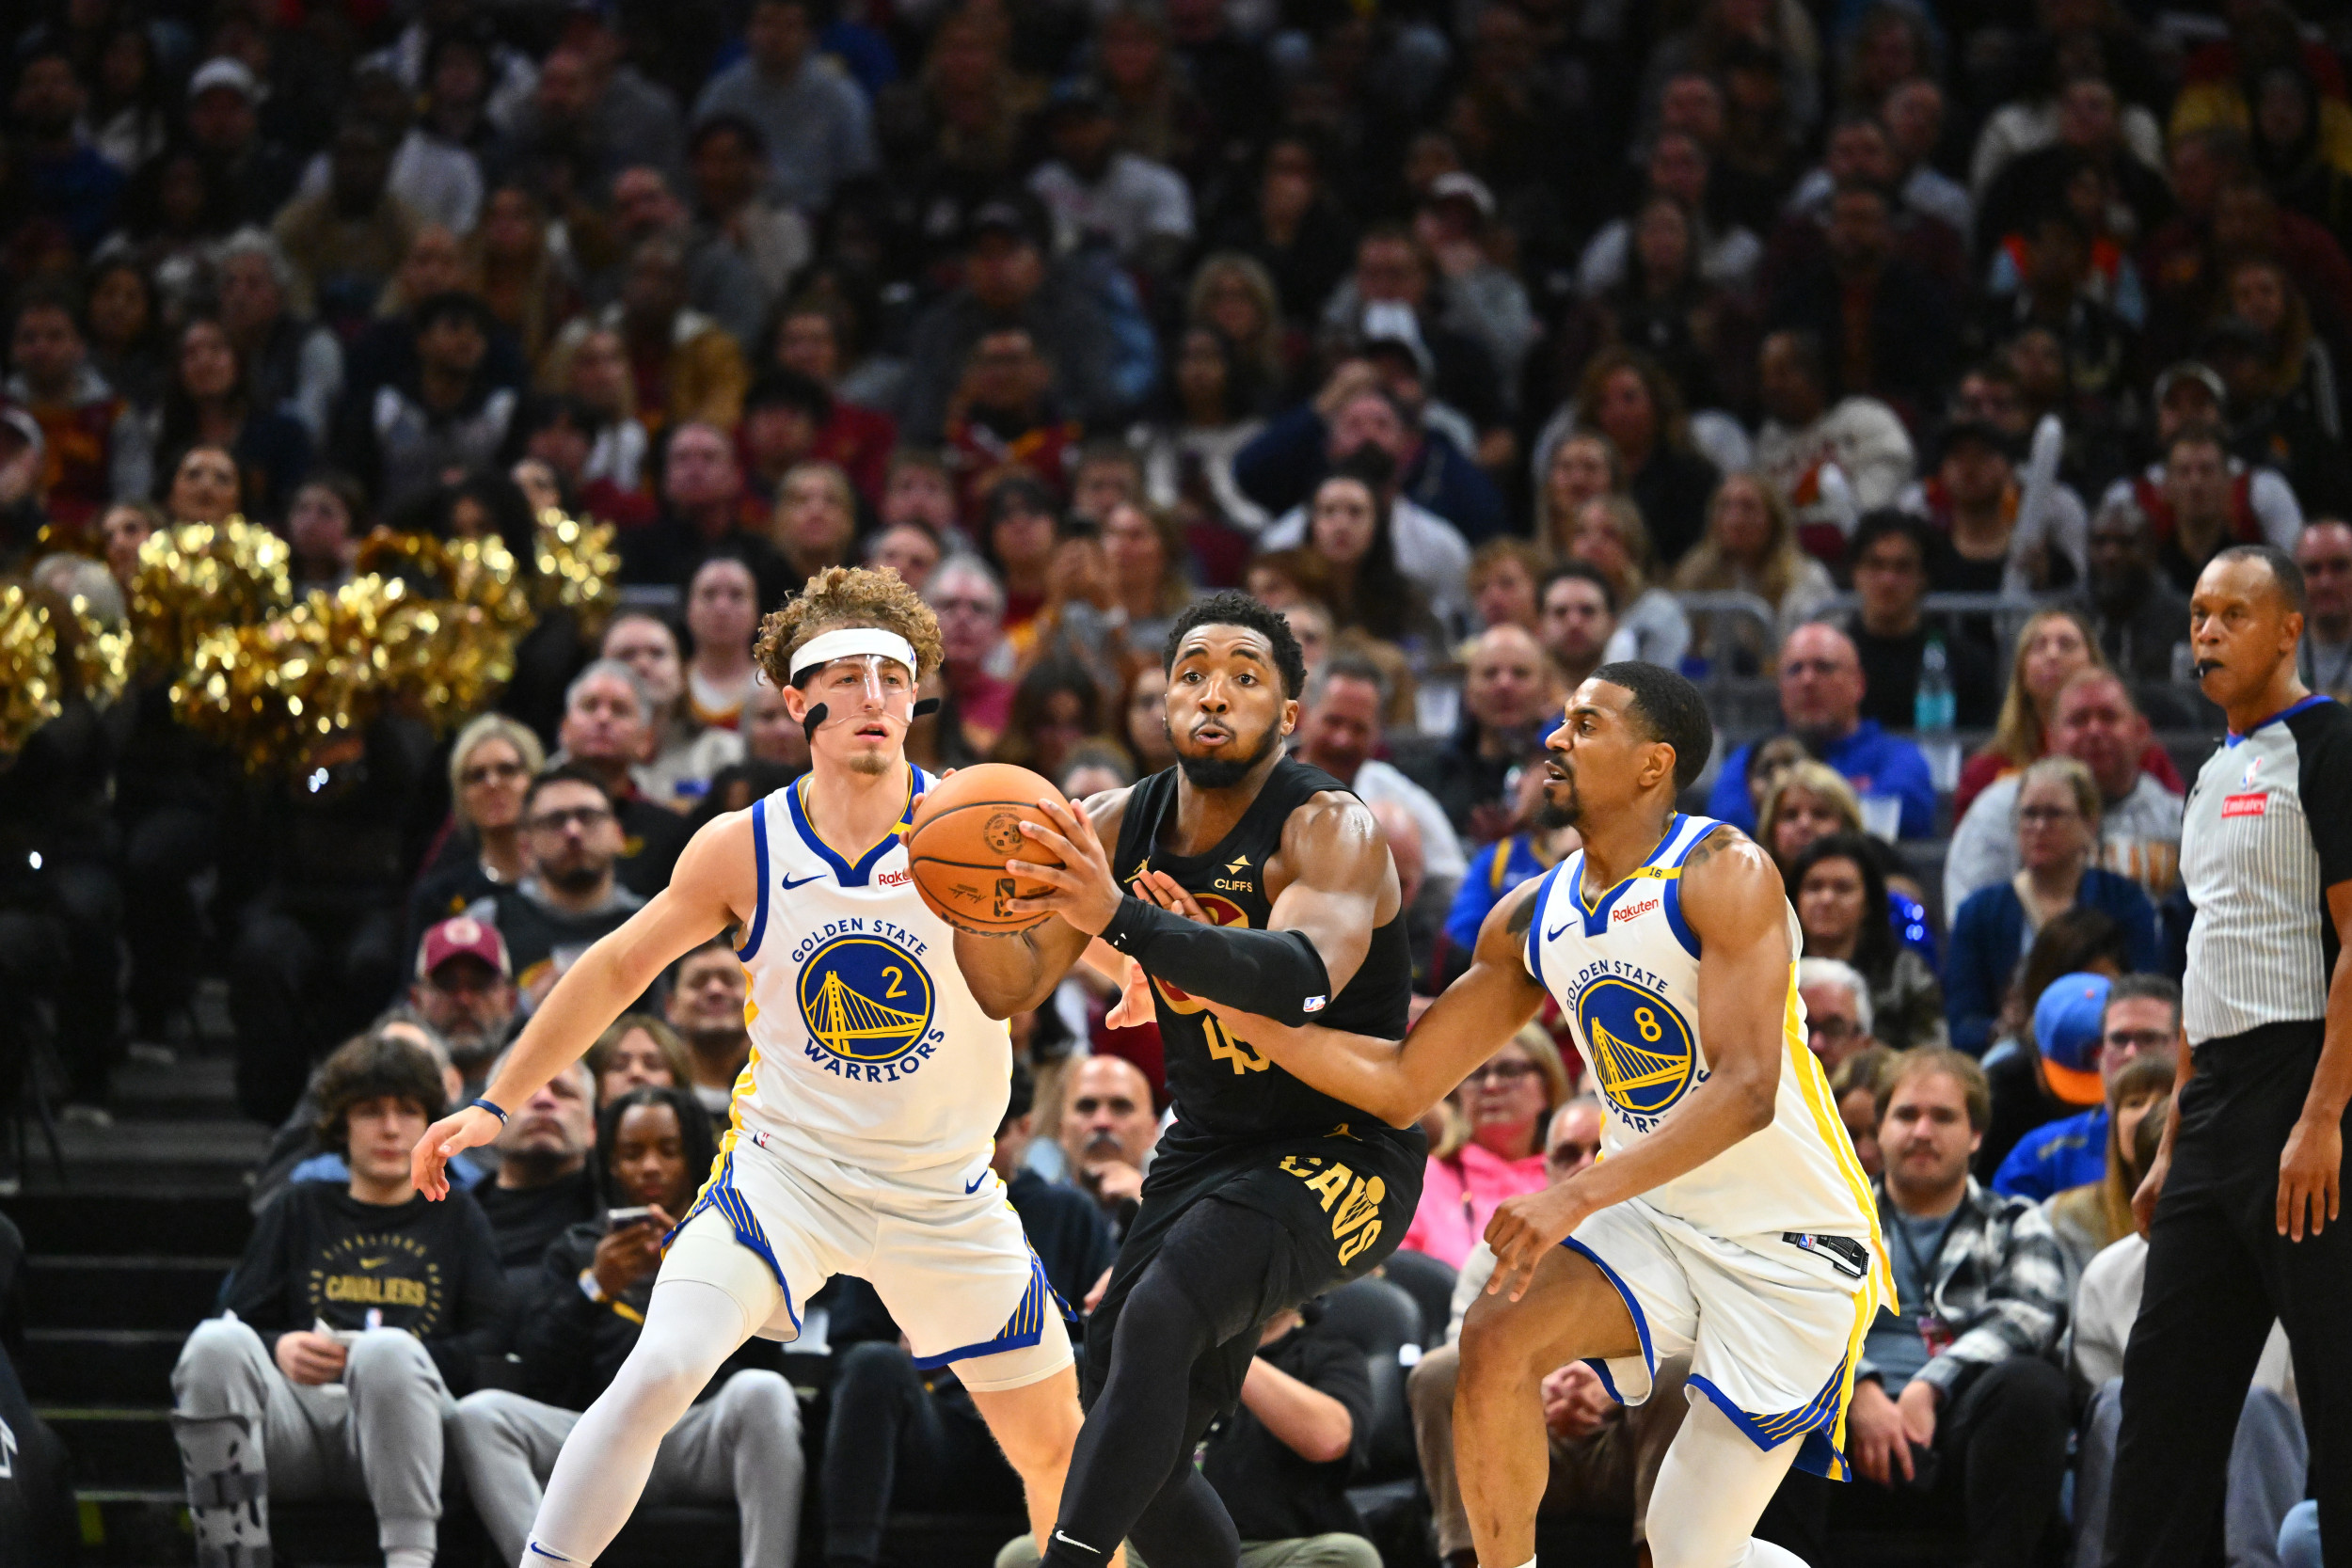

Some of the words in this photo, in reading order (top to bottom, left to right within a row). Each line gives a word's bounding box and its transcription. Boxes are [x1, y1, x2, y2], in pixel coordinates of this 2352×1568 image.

[2224, 799, 2265, 814] Emirates
[1214, 878, 1253, 893] CLIFFS
[1649, 867, 1662, 879] 16
[1613, 898, 1659, 922] Rakuten
[792, 917, 864, 963] GOLDEN
[873, 919, 929, 957] STATE
[881, 965, 908, 999] 2
[1566, 958, 1609, 1011] GOLDEN
[1614, 960, 1668, 993] STATE
[1633, 1006, 1662, 1042] 8
[804, 1028, 946, 1084] WARRIORS
[1279, 1155, 1386, 1267] CAVS
